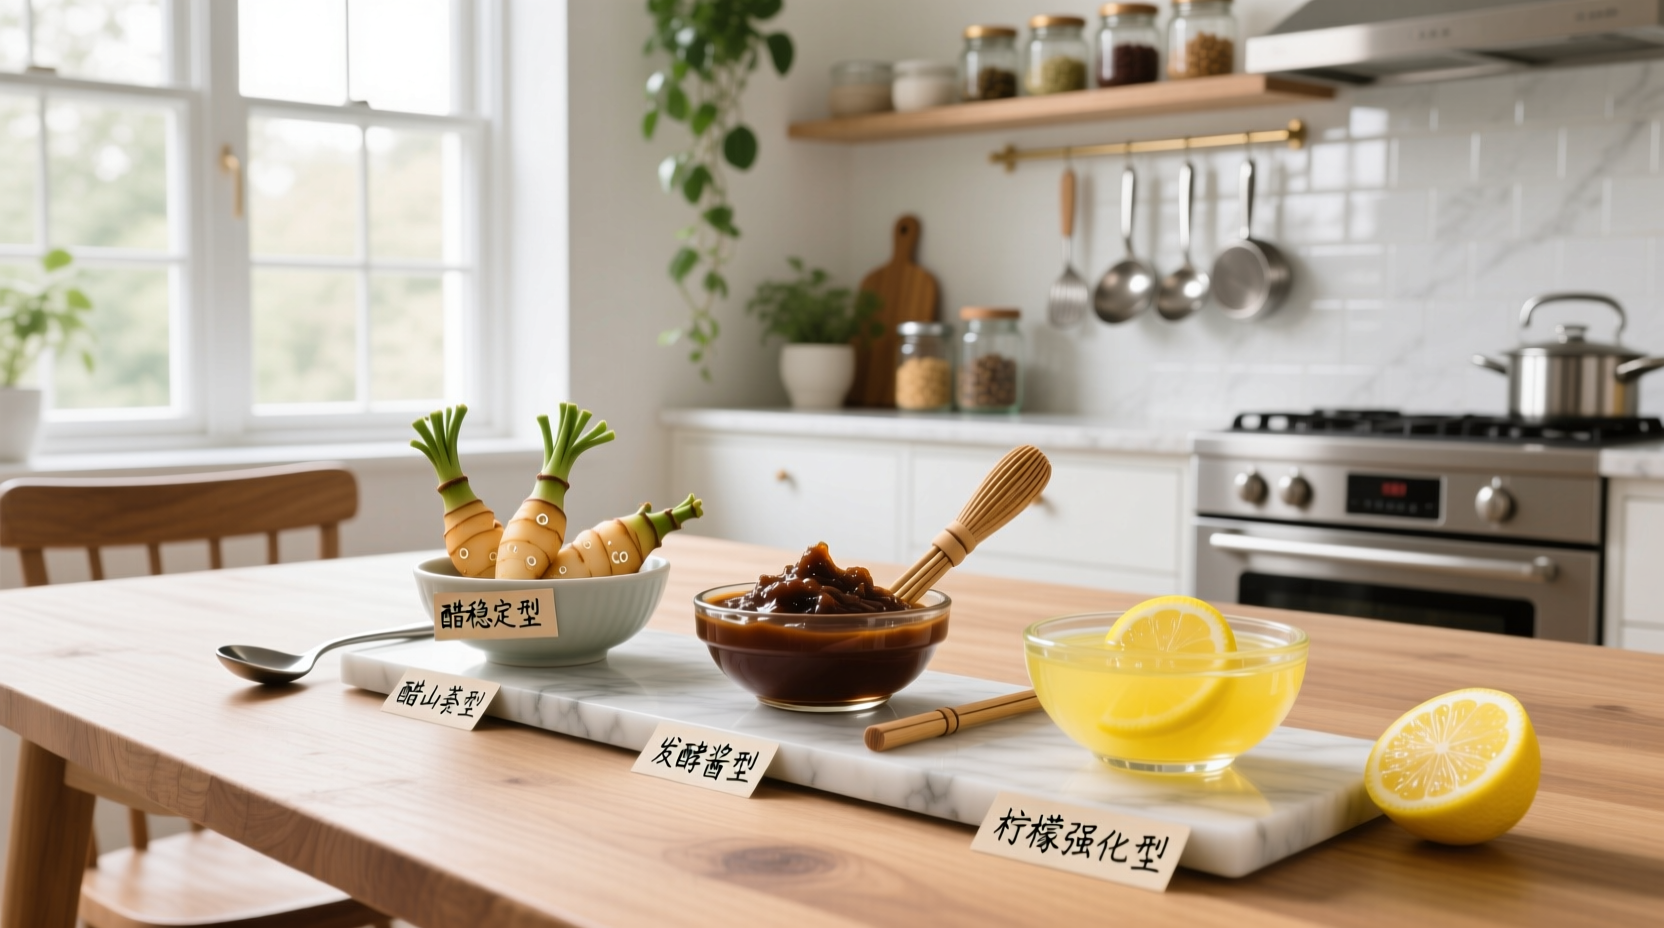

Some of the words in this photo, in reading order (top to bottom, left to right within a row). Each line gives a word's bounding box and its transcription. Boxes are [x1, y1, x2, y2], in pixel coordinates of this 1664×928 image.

[440, 597, 542, 630] 醋稳定型
[651, 736, 760, 783] 发酵酱型
[993, 807, 1170, 874] 柠檬强化型
